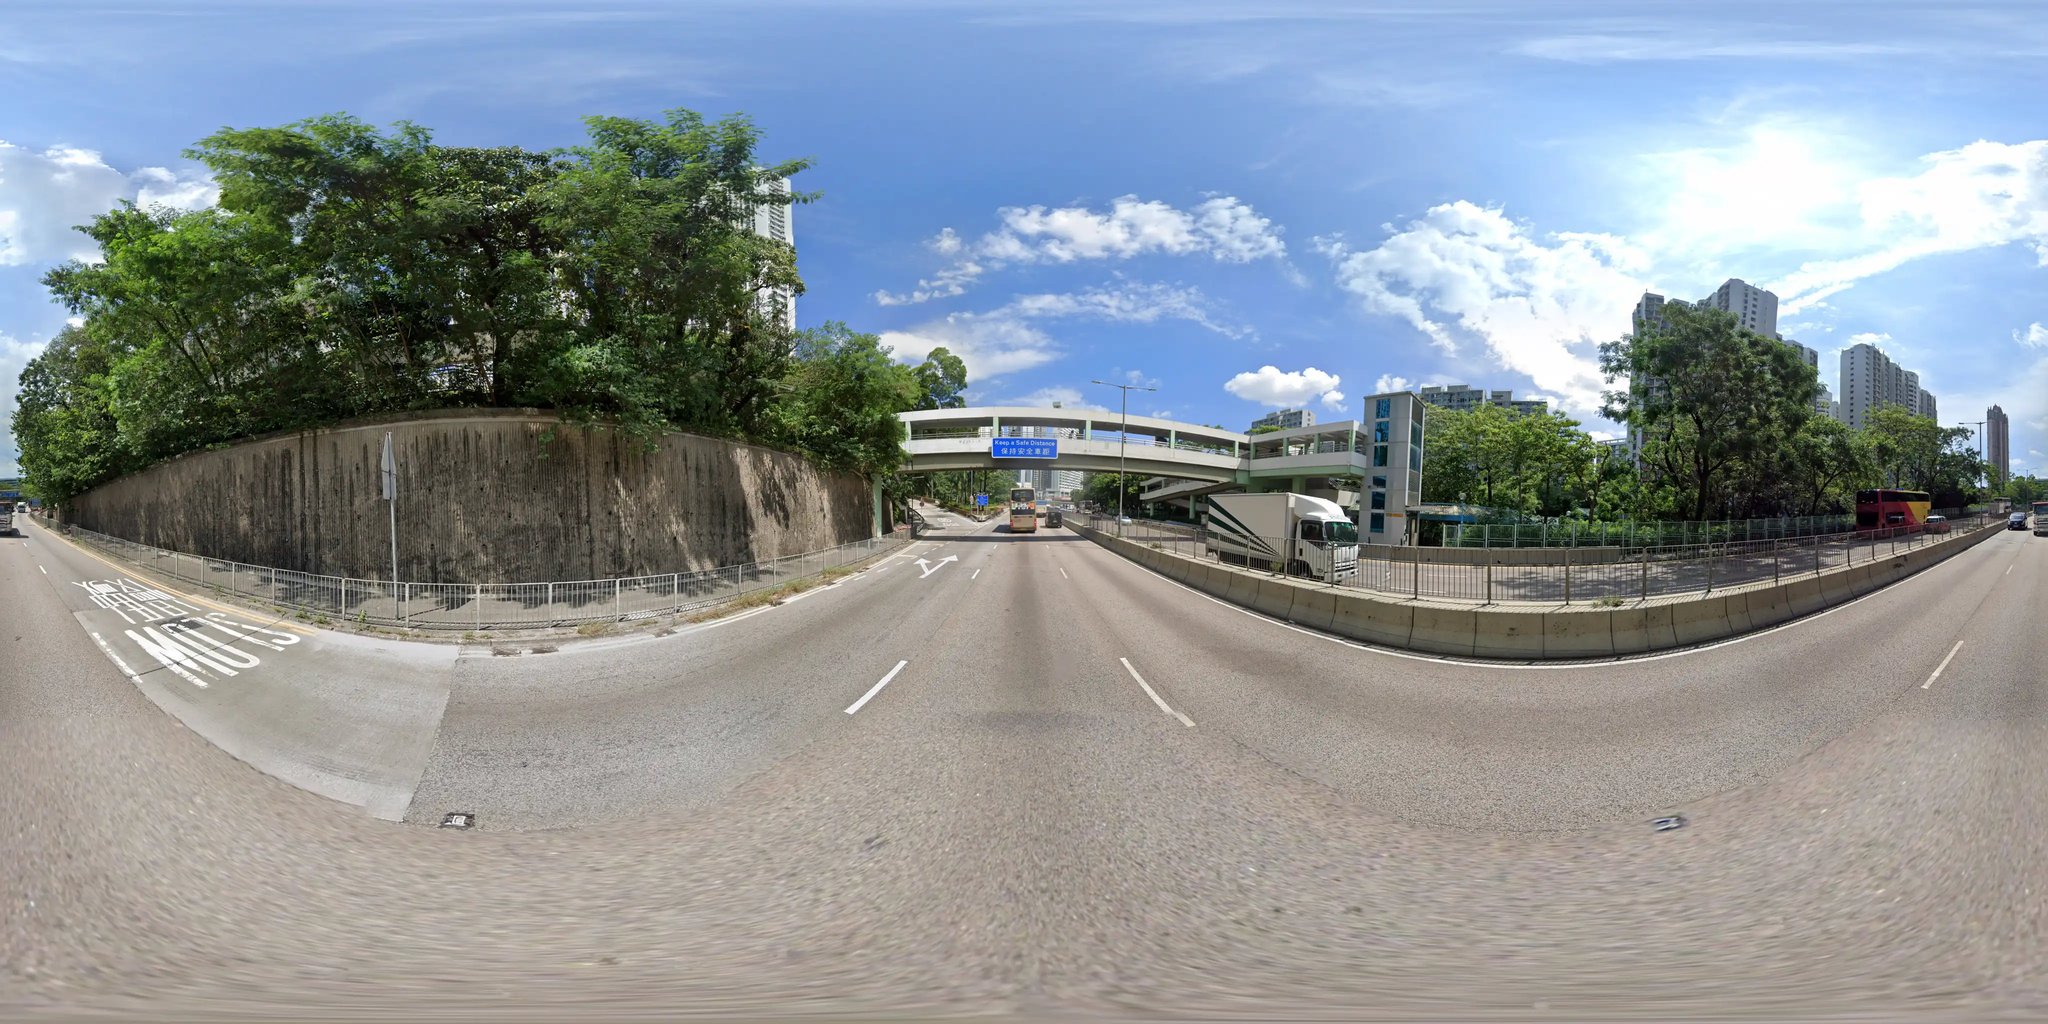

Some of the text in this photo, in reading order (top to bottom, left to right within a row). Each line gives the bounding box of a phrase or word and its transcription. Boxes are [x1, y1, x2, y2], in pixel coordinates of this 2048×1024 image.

[994, 439, 1010, 447] Keep
[1001, 447, 1050, 456] 保持安全車距
[124, 612, 301, 689] SLOW
